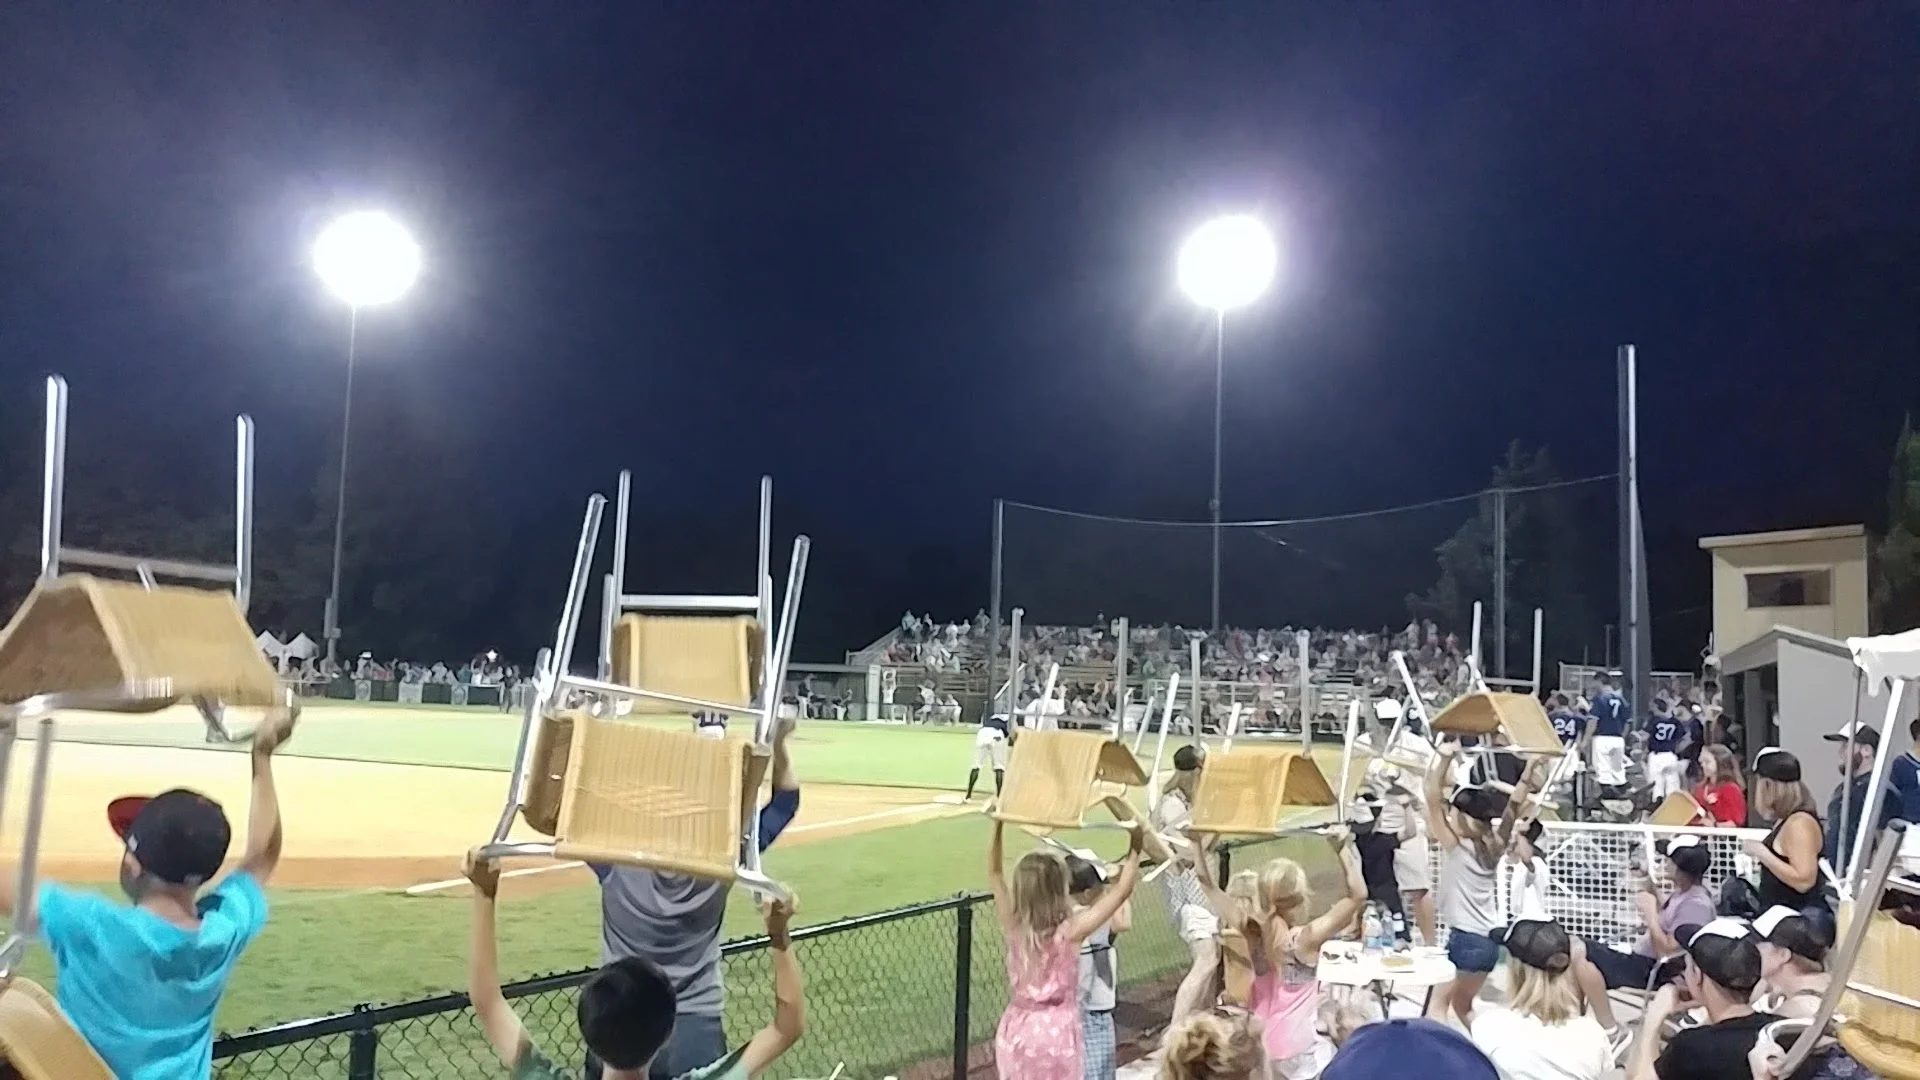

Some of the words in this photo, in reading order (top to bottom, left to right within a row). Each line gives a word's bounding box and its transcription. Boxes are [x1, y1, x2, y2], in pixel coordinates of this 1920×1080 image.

[1609, 698, 1621, 718] 7
[1554, 718, 1576, 736] 24
[1655, 722, 1676, 740] 37
